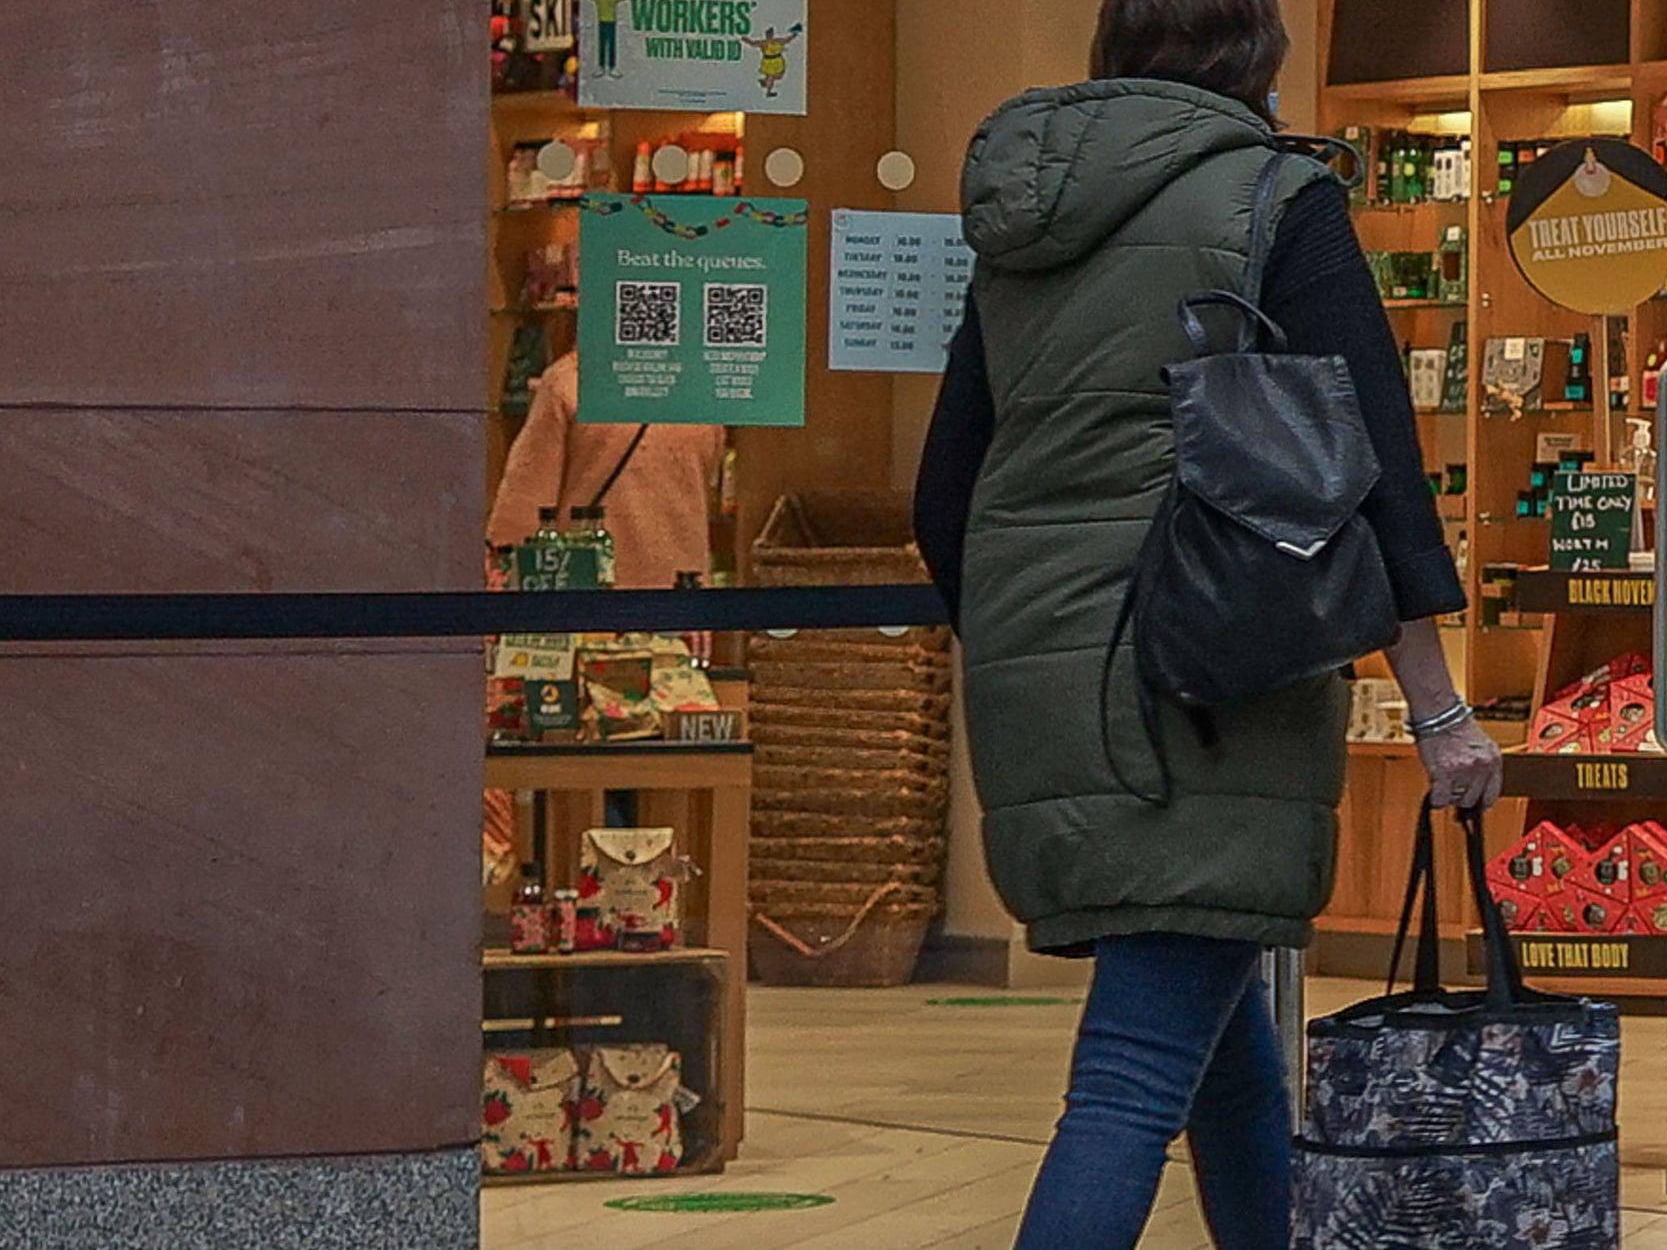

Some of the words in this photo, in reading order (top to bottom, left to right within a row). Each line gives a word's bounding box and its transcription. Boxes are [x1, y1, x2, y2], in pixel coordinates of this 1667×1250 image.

[645, 37, 685, 59] WITH
[686, 38, 727, 60] VALID
[729, 39, 742, 61] ID
[1529, 216, 1579, 248] TREAT
[1582, 207, 1667, 243] YOURSELF
[618, 249, 660, 267] Beat
[663, 250, 694, 268] the
[697, 256, 767, 273] queues.
[1532, 247, 1565, 261] ALL
[1596, 495, 1632, 512] ONLY
[1568, 578, 1612, 605] BLACK
[680, 715, 733, 740] NEW
[1576, 763, 1628, 789] TREATS
[1522, 941, 1555, 967] LOVE
[1558, 942, 1588, 968] THAT
[1593, 943, 1629, 968] BODY
